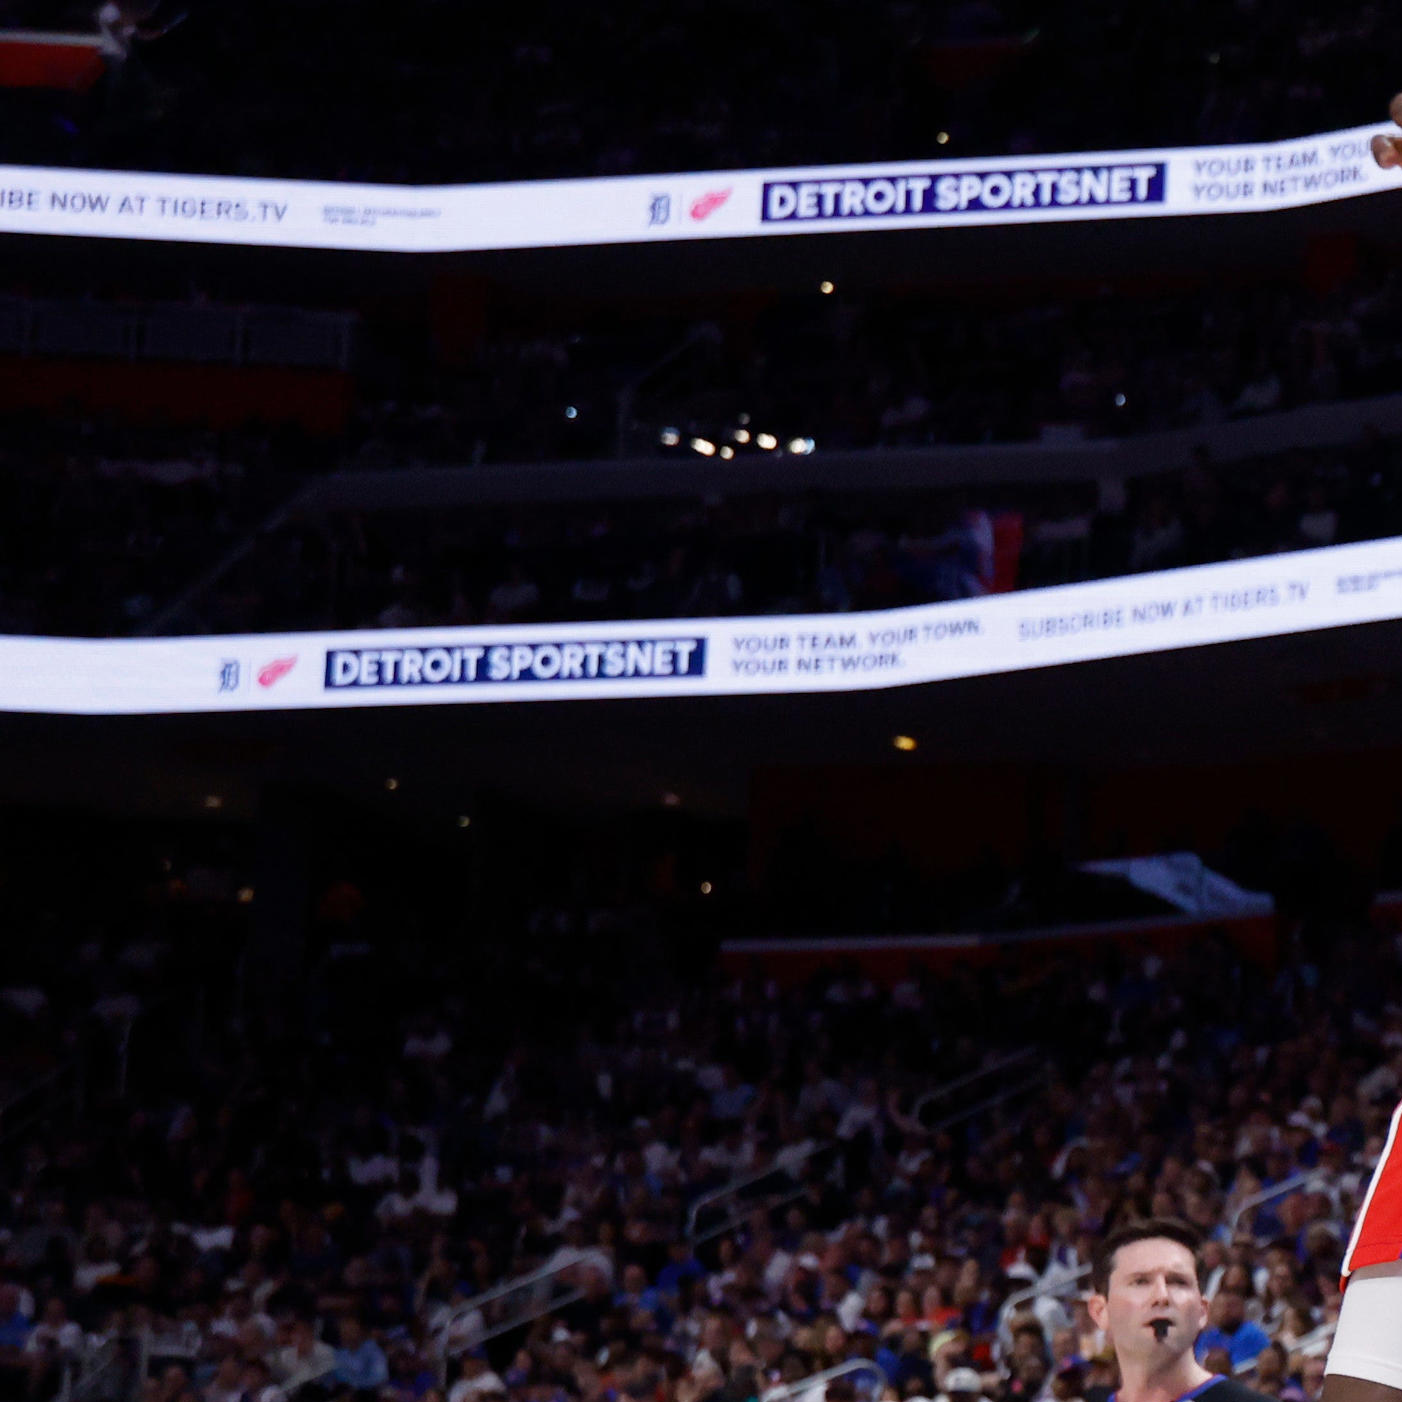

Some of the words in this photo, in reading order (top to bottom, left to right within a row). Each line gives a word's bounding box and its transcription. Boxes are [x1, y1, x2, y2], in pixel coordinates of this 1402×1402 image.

[1194, 158, 1253, 178] YOUR
[769, 179, 930, 218] DETROIT
[935, 166, 1157, 210] SPORTSNET
[1191, 179, 1253, 201] YOUR
[50, 191, 110, 214] NOW
[119, 195, 145, 214] AT
[160, 198, 289, 222] TIGERS.TV
[1019, 608, 1125, 640] SUBSCRIBE
[1132, 601, 1174, 622] NOW
[1183, 597, 1204, 616] AT
[734, 635, 791, 654] YOUR
[869, 626, 918, 648] YOUR
[334, 647, 485, 686] DETROIT
[490, 639, 698, 681] SPORTSNET
[732, 656, 791, 675] YOUR
